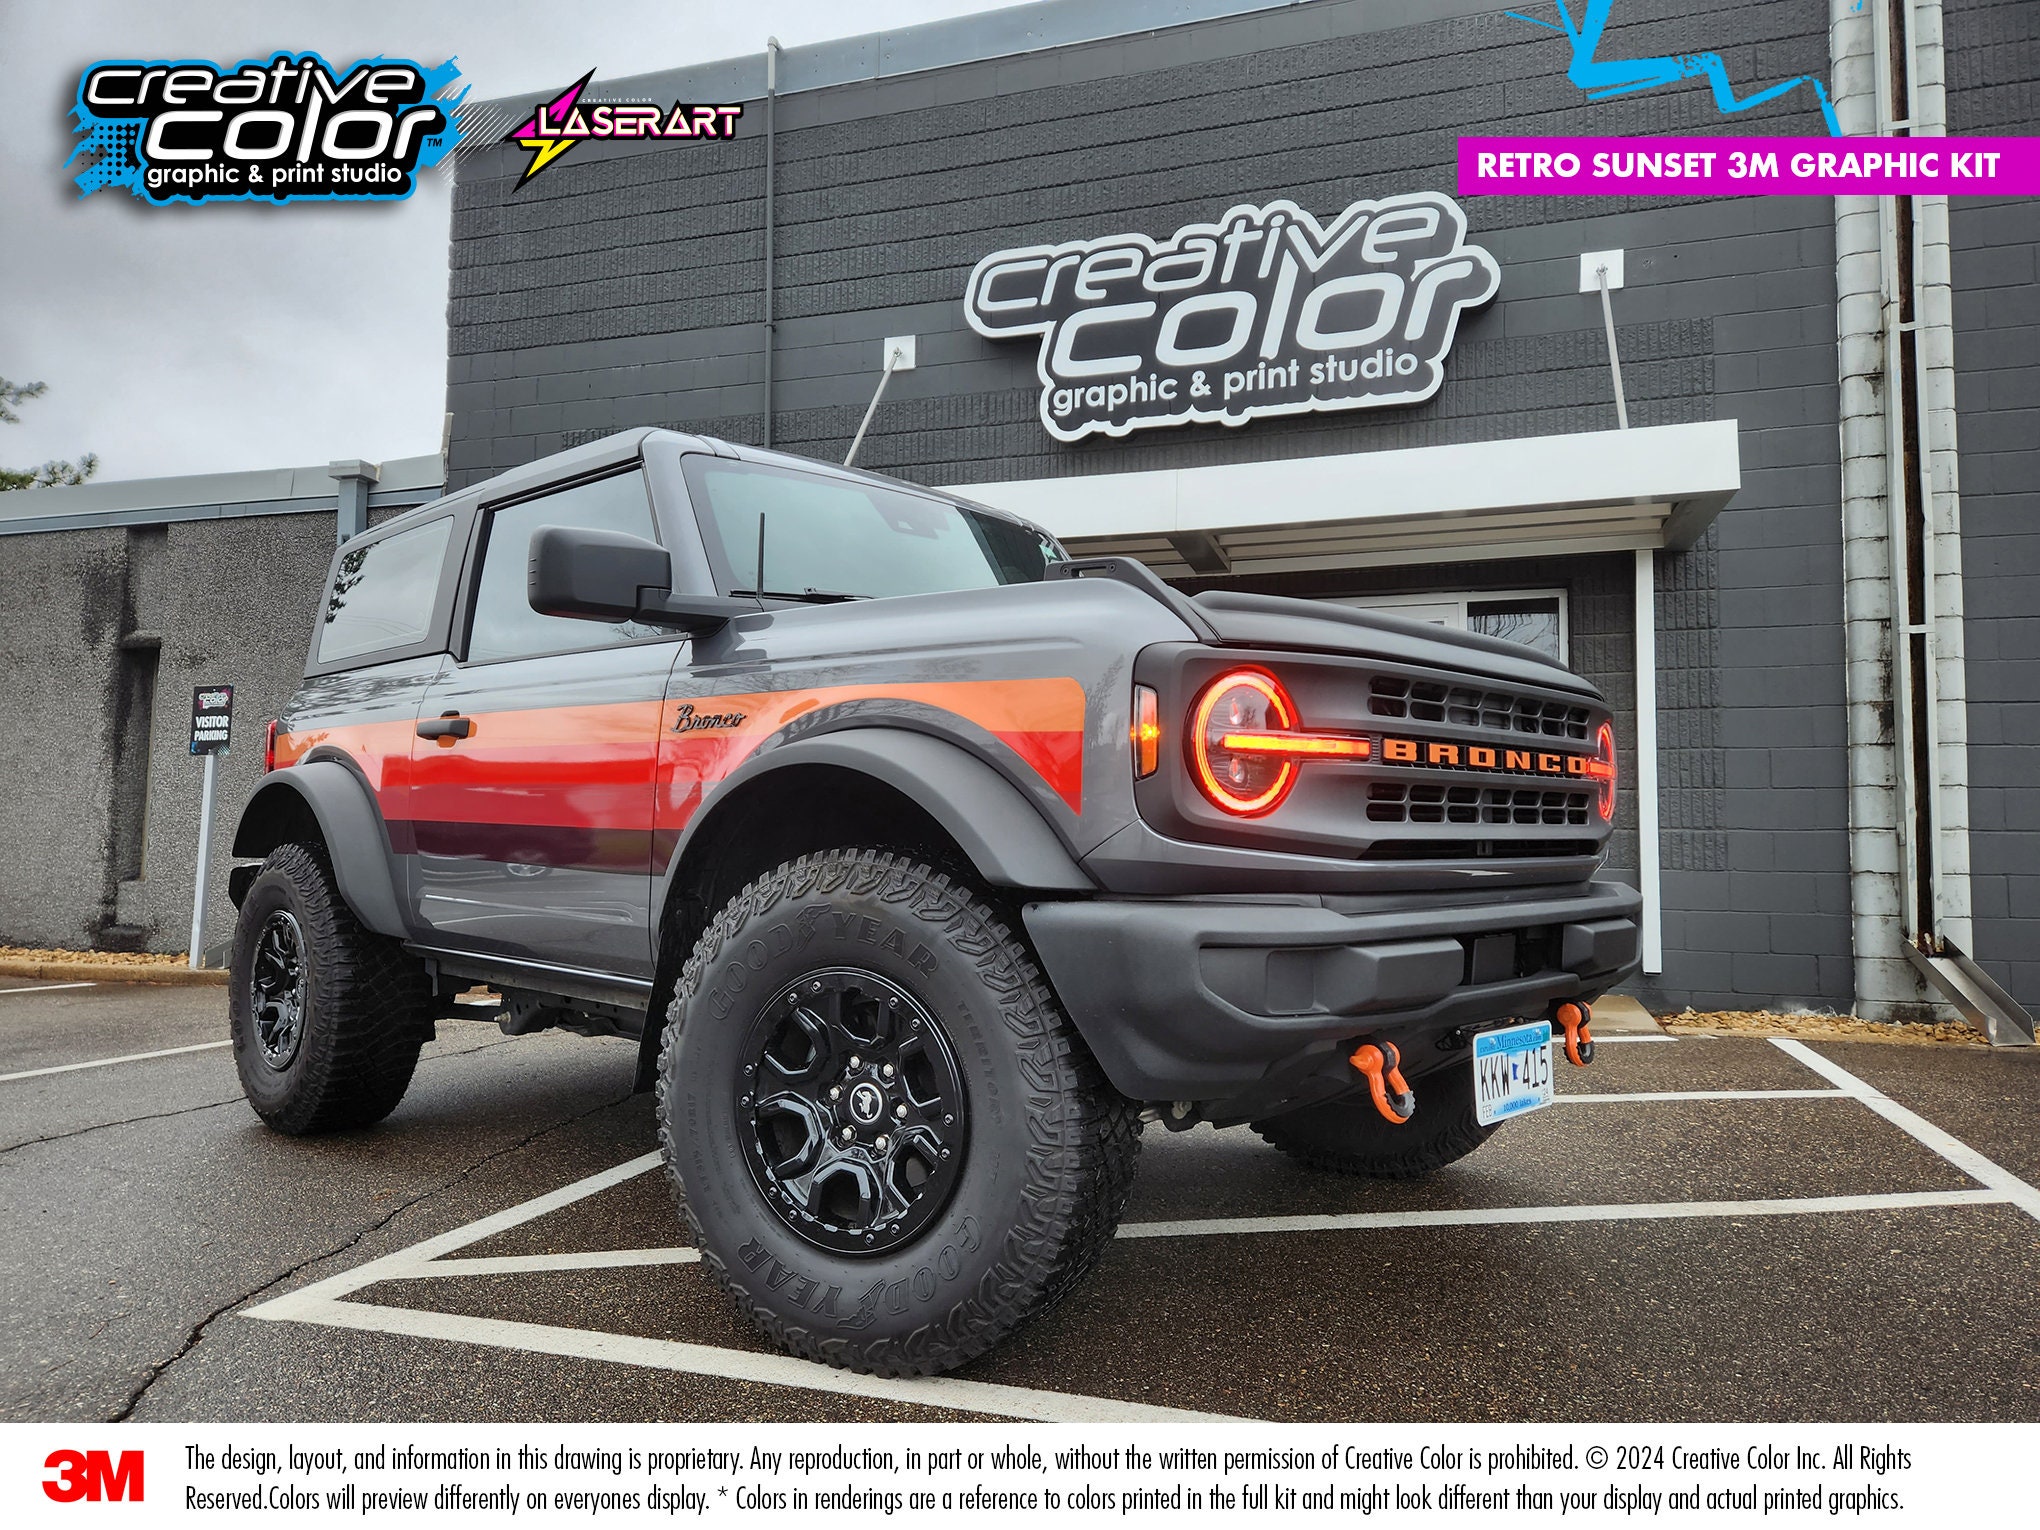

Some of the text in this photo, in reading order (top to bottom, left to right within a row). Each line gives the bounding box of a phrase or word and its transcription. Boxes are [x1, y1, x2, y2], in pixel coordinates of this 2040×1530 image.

[977, 207, 1441, 312] creative
[1051, 250, 1474, 378] color
[1053, 348, 1419, 416] graphic & print studio
[193, 730, 229, 742] PARKING
[195, 715, 230, 729] VISITOR
[671, 703, 747, 733] Bronco
[1383, 738, 1587, 775] BRONCO
[1479, 1044, 1549, 1103] KKW 415
